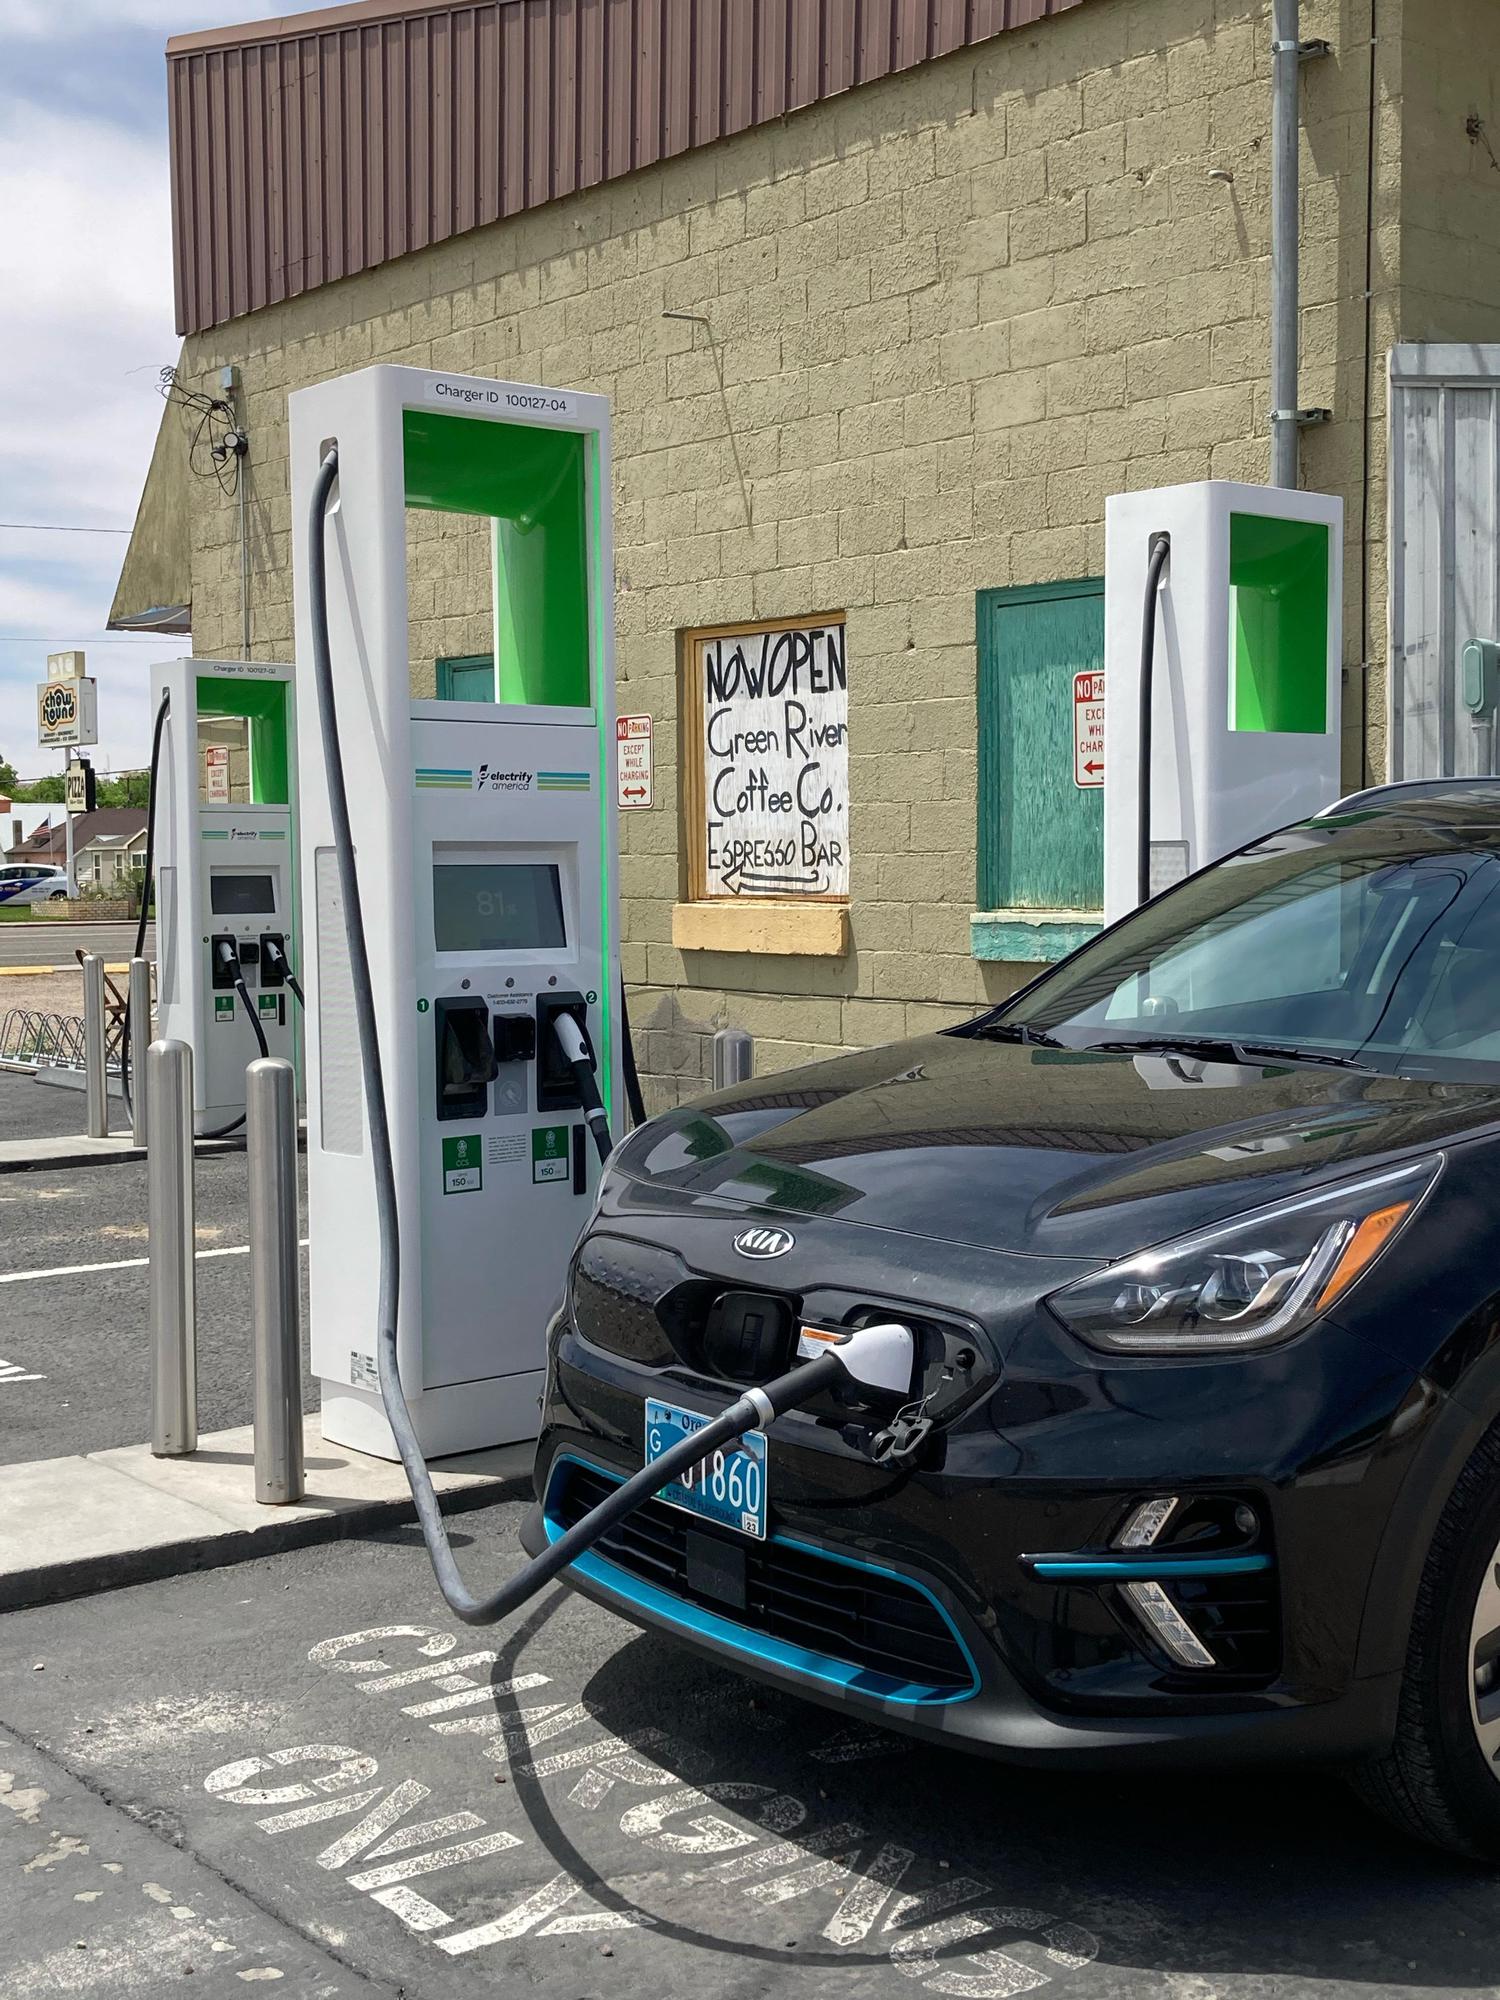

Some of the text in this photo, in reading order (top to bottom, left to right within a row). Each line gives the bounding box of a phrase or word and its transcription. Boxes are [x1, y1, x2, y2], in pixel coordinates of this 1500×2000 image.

[435, 383, 567, 411] Charger ID 100127-04
[213, 665, 236, 673] Charger
[706, 625, 848, 703] NOW OPEN
[1076, 680, 1091, 698] NO
[45, 688, 72, 708] chow
[42, 702, 74, 726] hound
[617, 722, 650, 738] NO PARKING
[707, 700, 848, 762] Green River
[623, 744, 644, 756] EXCEPT
[625, 758, 642, 768] WHILE
[490, 771, 533, 784] electrify
[620, 770, 649, 782] CHARGING
[68, 776, 84, 798] PIZZA
[492, 782, 530, 791] america
[712, 762, 842, 819] Coffee Co.
[541, 1168, 554, 1176] 150
[452, 1178, 466, 1186] 150
[739, 1228, 783, 1253] KIA
[746, 1521, 756, 1533] 23
[203, 1742, 657, 1955] ONLY
